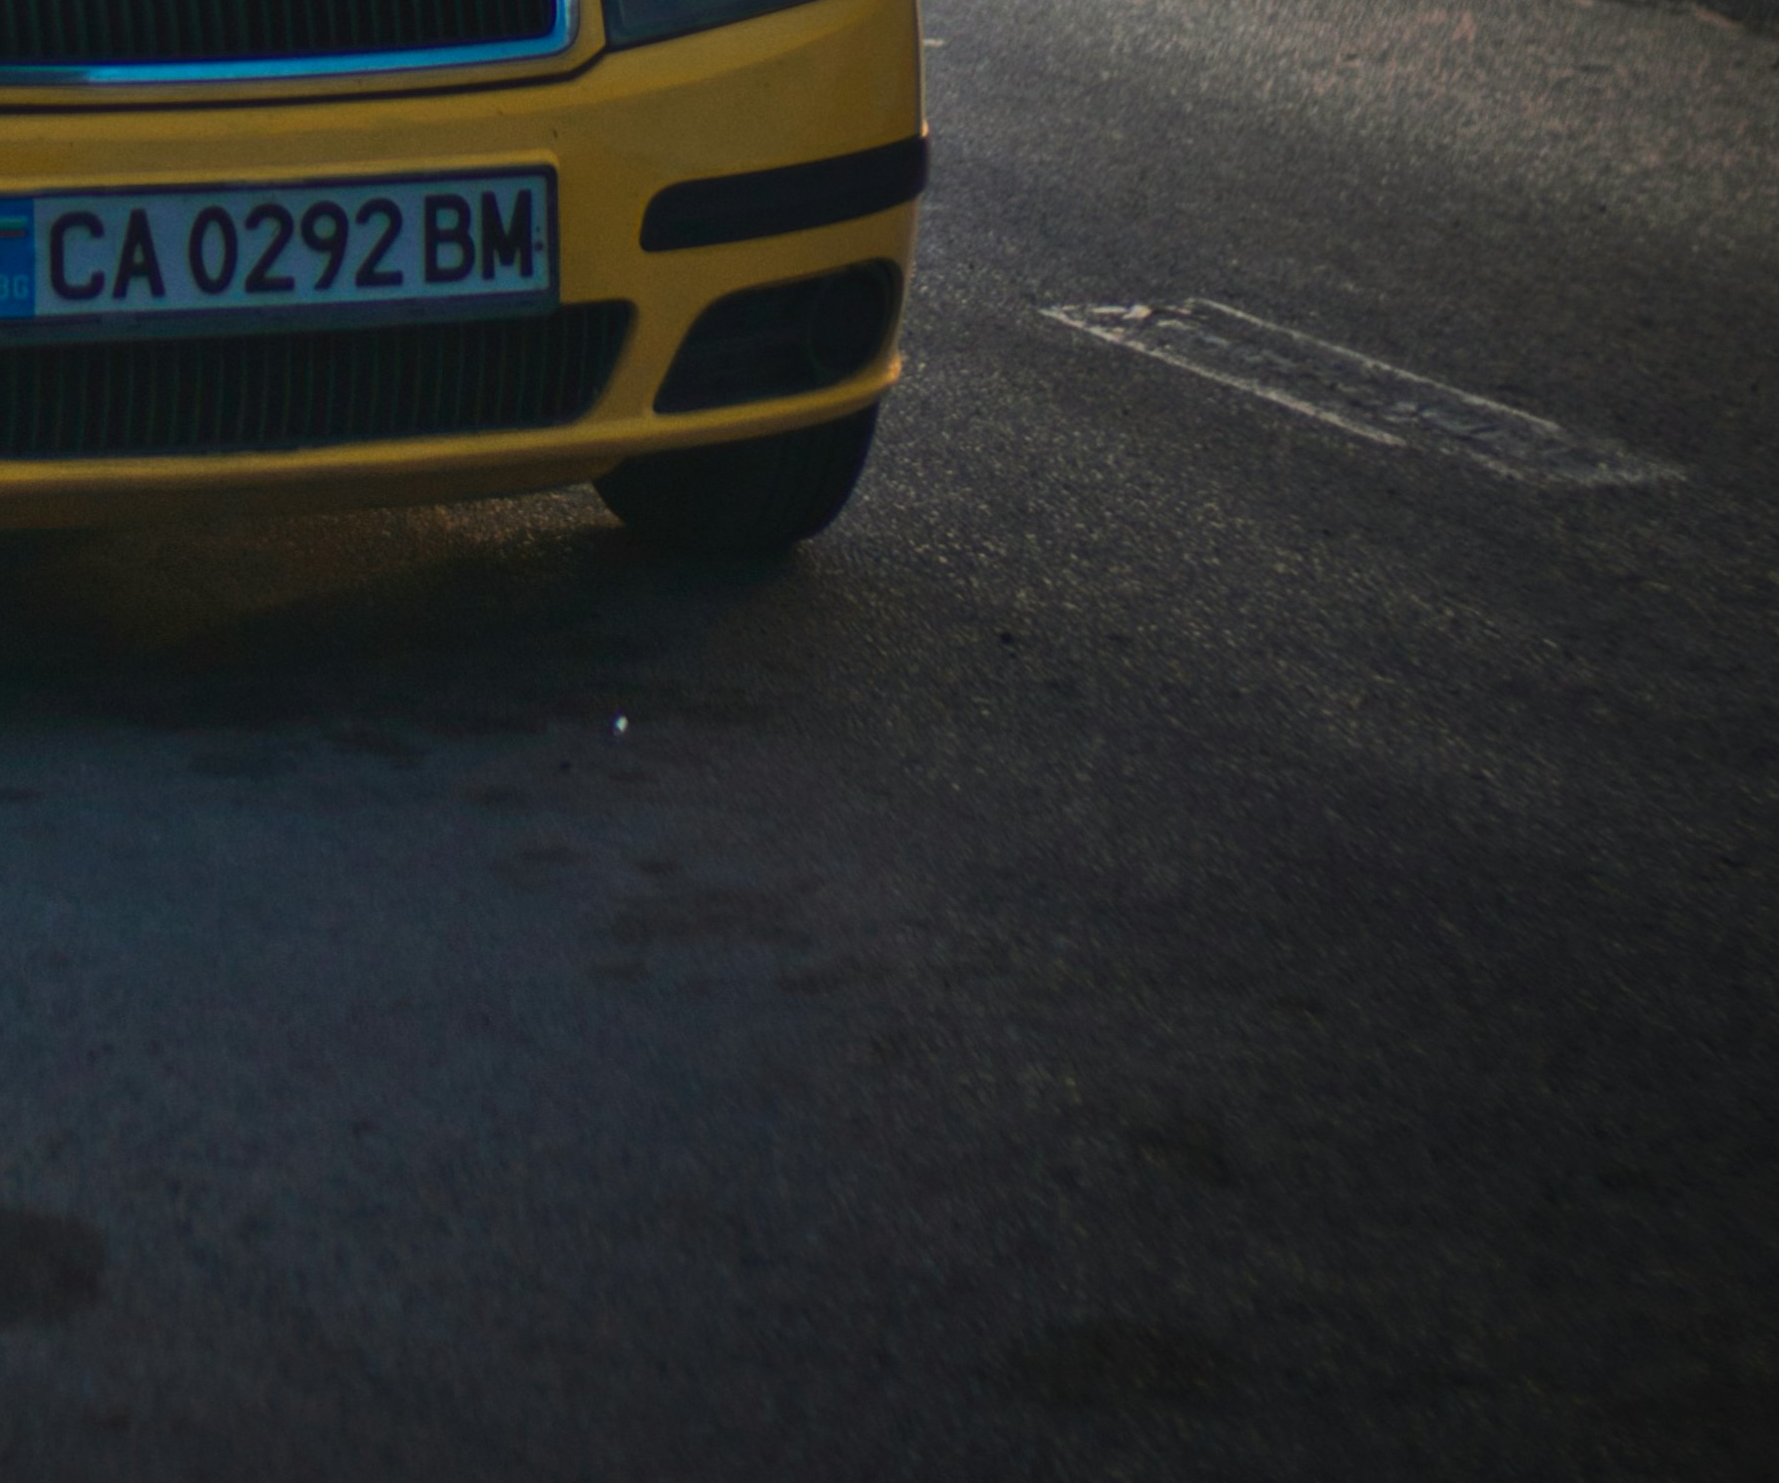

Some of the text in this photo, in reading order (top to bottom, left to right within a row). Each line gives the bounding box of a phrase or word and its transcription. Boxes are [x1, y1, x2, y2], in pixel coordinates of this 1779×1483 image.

[49, 188, 534, 300] CA 0292 BM
